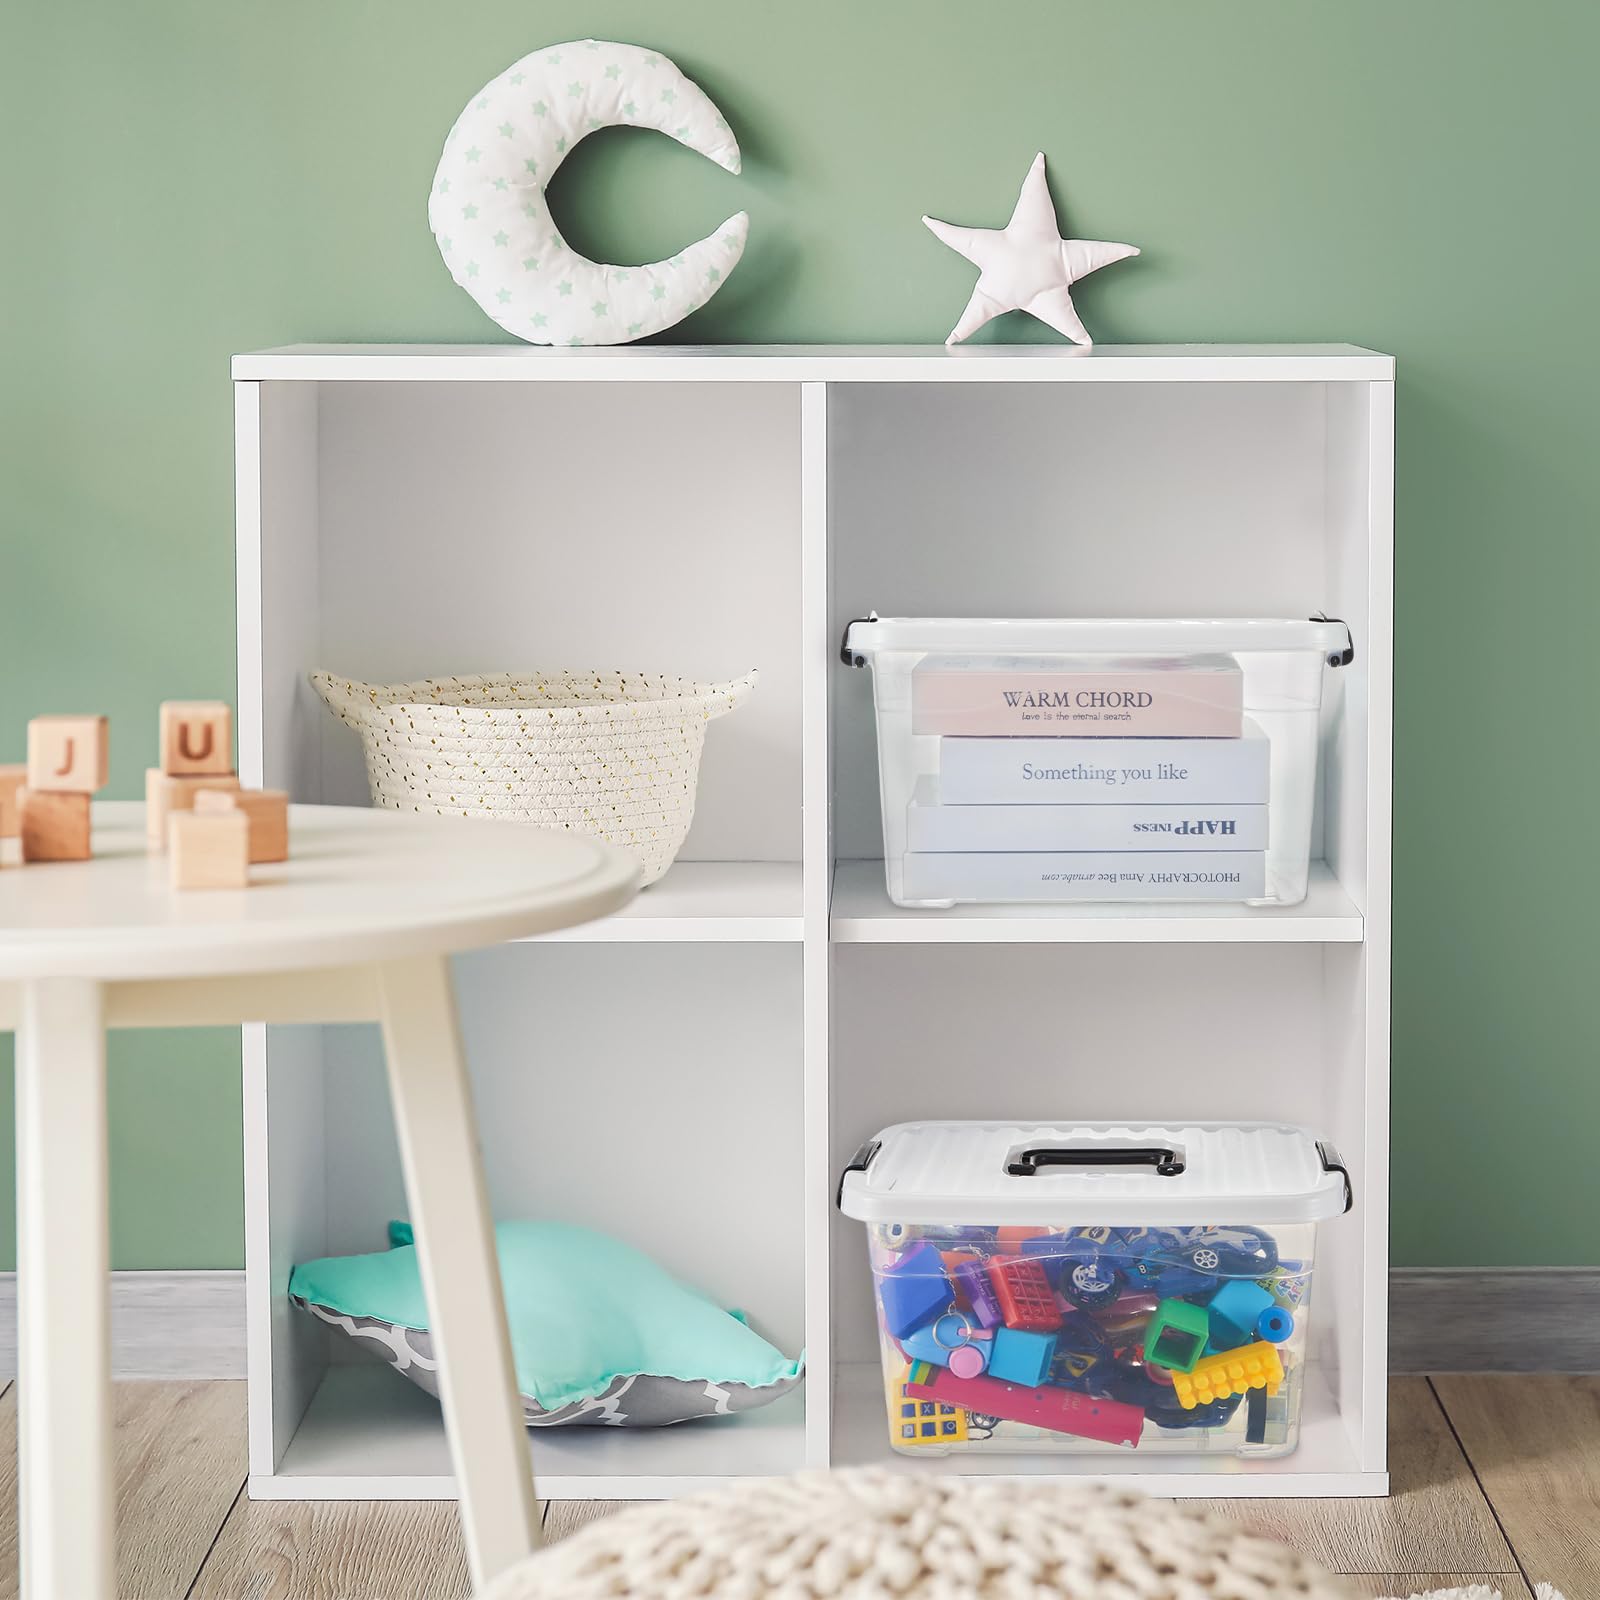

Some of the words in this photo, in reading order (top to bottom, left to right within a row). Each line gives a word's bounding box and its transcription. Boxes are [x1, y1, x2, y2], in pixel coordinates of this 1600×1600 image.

[1003, 691, 1070, 708] WARM
[1075, 691, 1153, 708] CHORD
[1043, 712, 1053, 721] is
[1056, 712, 1070, 721] the
[1103, 712, 1132, 721] search
[179, 723, 213, 760] U
[55, 738, 74, 776] J
[1022, 763, 1117, 785] Something
[1120, 768, 1153, 785] you
[1157, 763, 1189, 780] like
[1097, 872, 1118, 883] Bee
